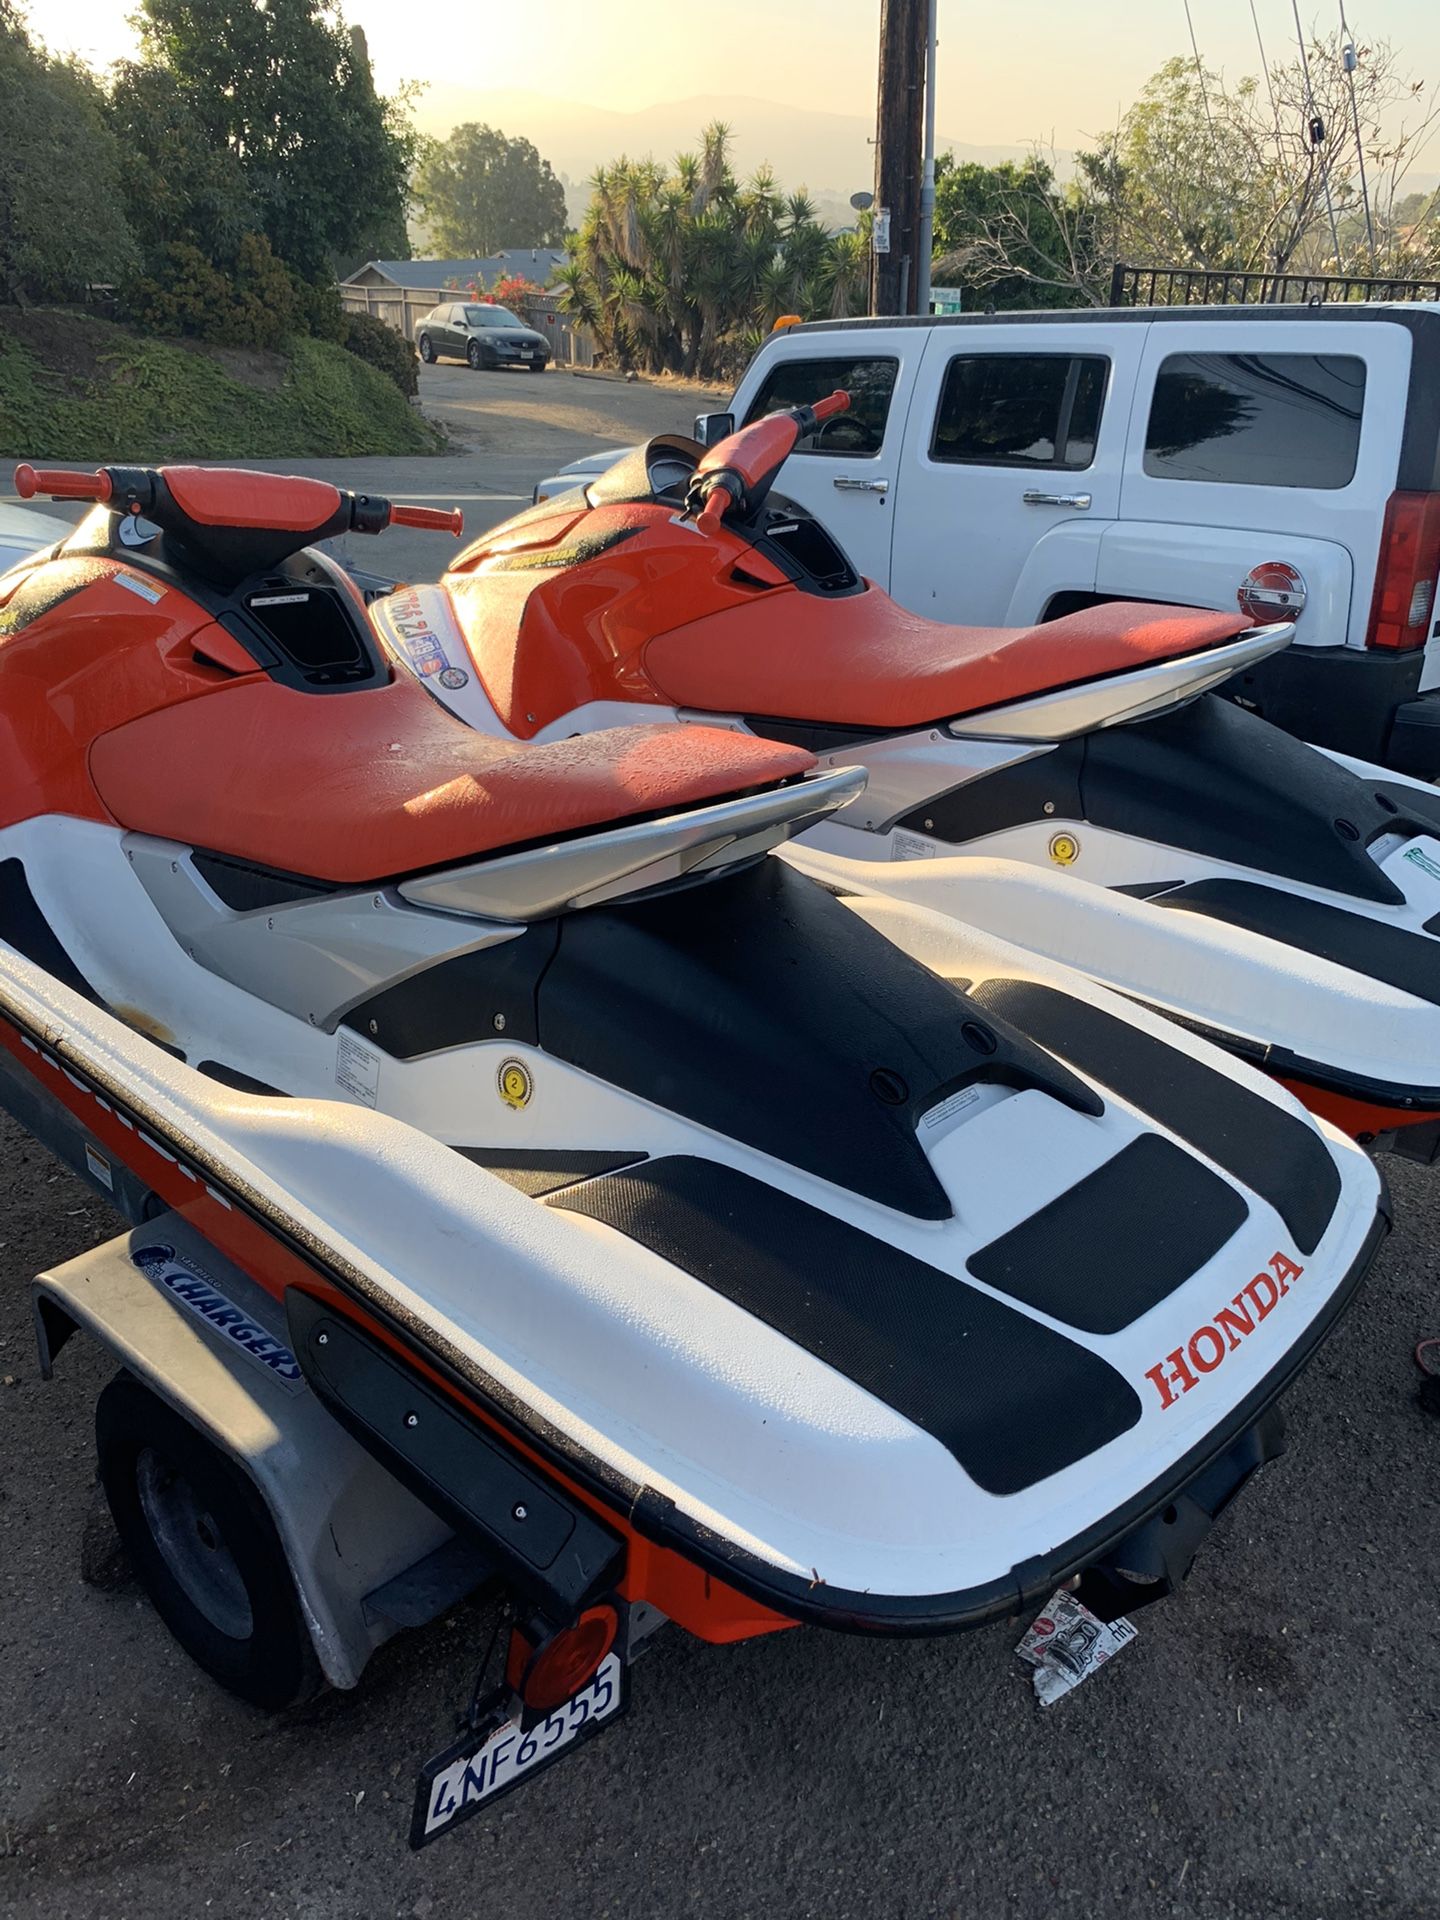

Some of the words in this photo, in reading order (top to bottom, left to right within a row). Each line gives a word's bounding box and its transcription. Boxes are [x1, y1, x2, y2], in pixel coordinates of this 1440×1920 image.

[1060, 844, 1067, 853] 2
[511, 1077, 518, 1089] 2
[164, 1273, 301, 1380] CHARGERS
[1144, 1251, 1304, 1411] HONDA
[432, 1664, 614, 1819] 4NF6555
